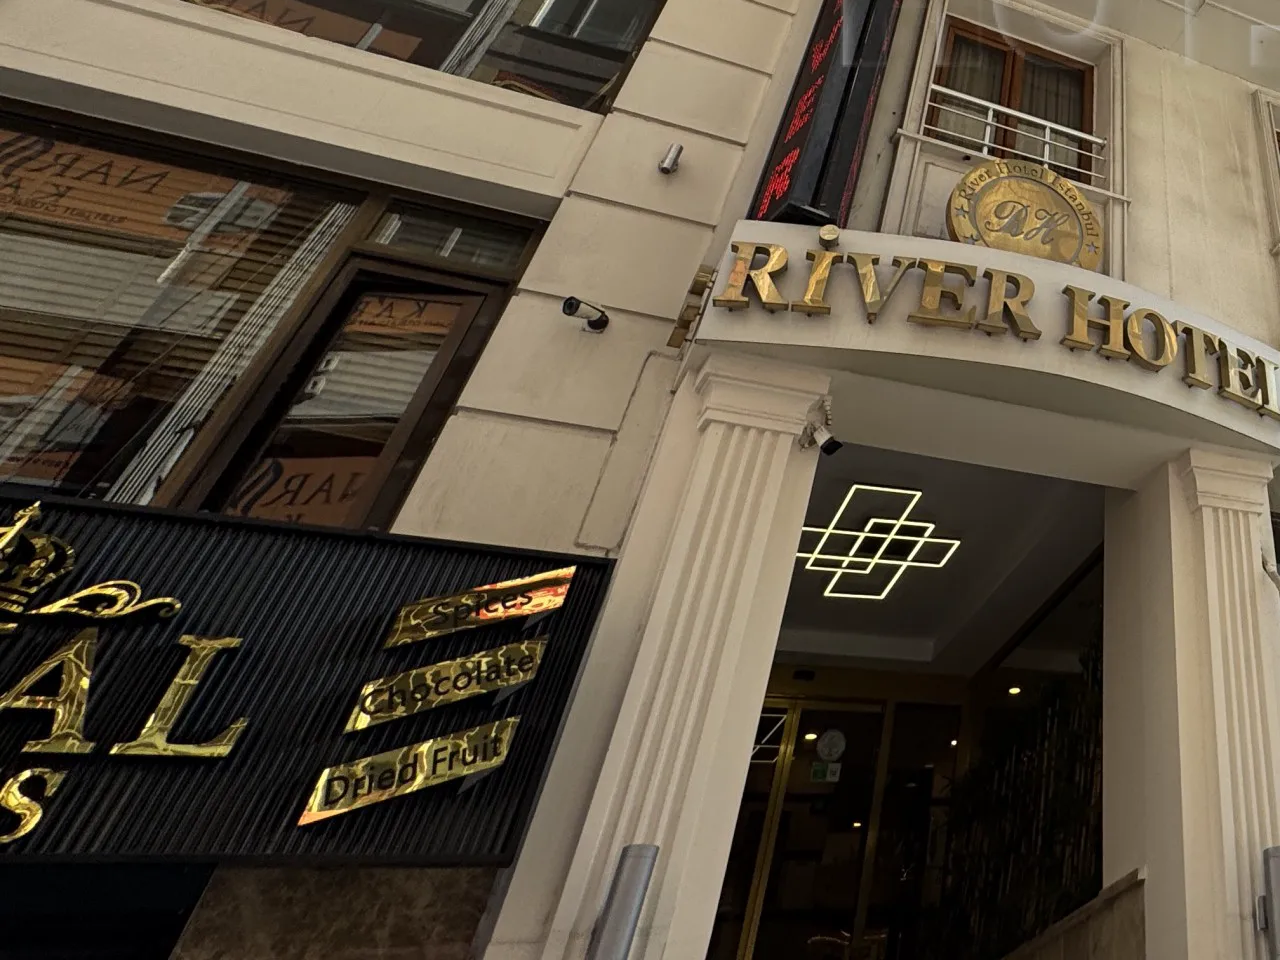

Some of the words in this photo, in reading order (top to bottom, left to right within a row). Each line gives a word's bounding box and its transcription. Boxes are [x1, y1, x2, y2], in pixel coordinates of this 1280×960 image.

[957, 168, 993, 201] River
[996, 161, 1045, 179] Hotel
[1050, 173, 1100, 238] Istanbul
[431, 590, 534, 626] Spices
[359, 653, 535, 717] Chocolate
[323, 751, 419, 807] Dried
[431, 734, 505, 776] Fruit
